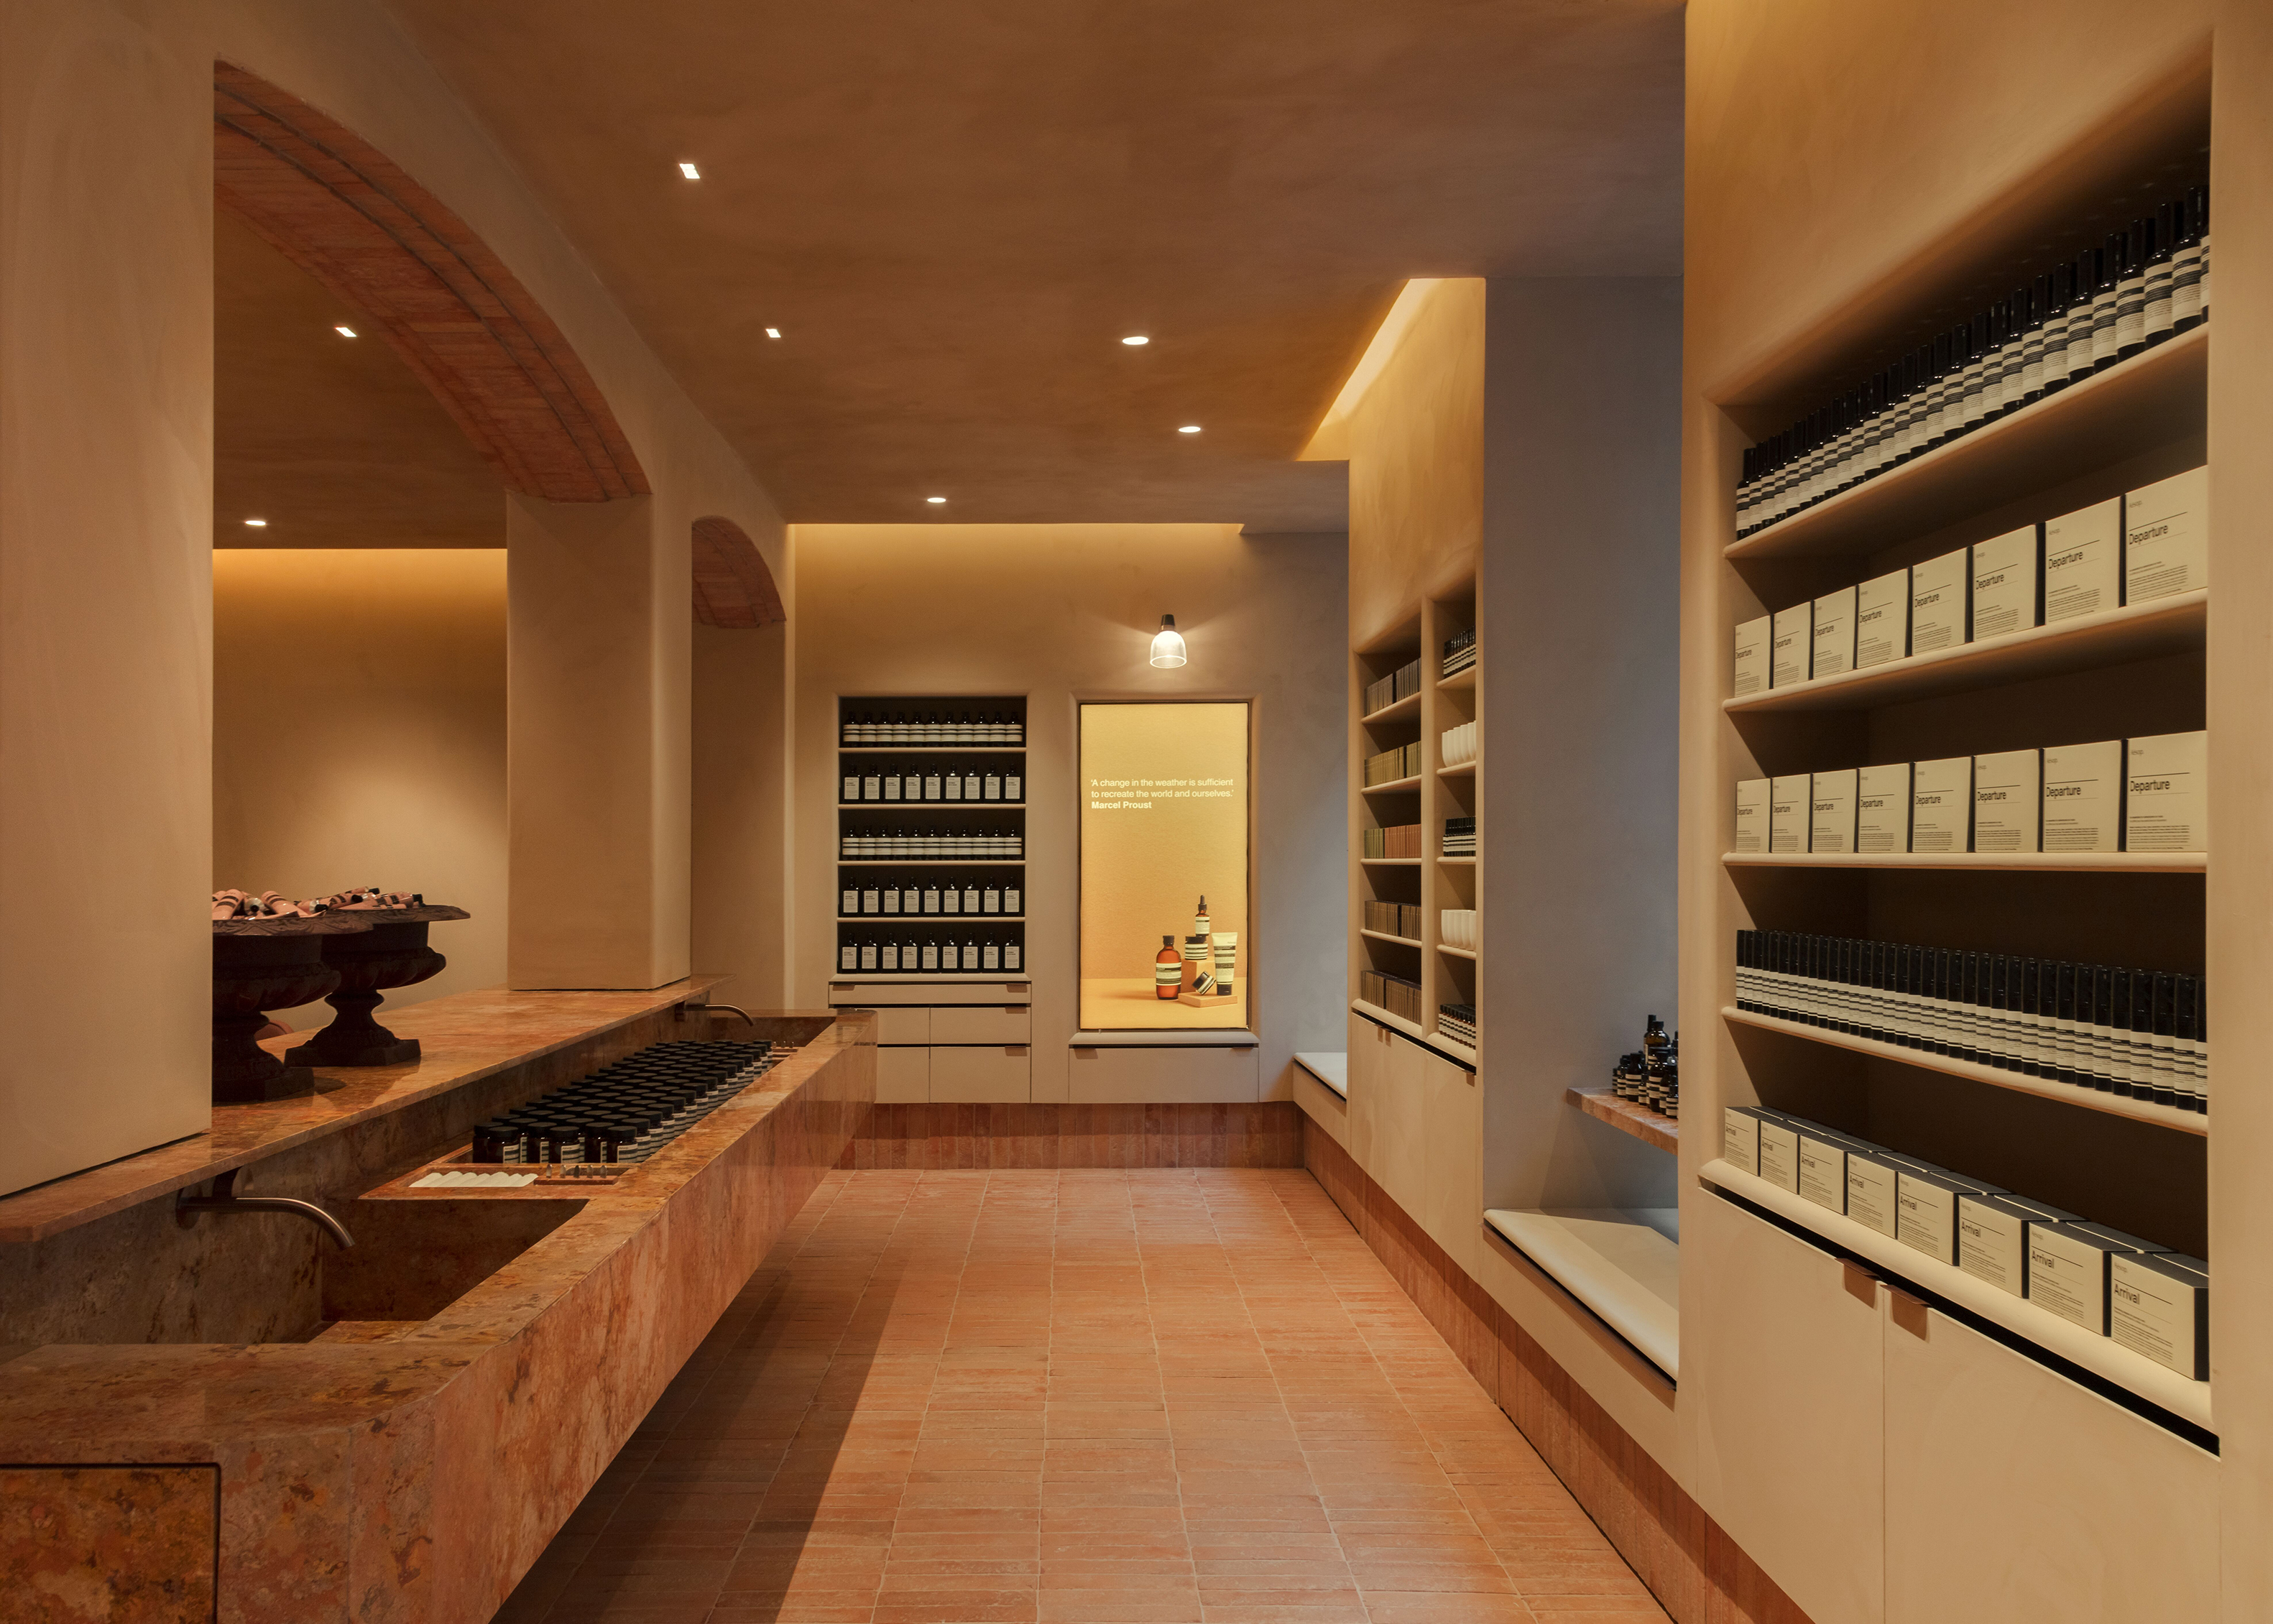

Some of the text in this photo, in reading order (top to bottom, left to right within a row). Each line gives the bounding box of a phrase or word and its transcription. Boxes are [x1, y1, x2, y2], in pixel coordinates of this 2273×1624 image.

[2129, 525, 2169, 545] Departure
[2049, 551, 2083, 569] Departure
[1976, 574, 2004, 590] Departure
[1914, 594, 1940, 608] Departure
[1860, 610, 1882, 624] Departure
[1815, 625, 1834, 637] Departure
[1100, 779, 1130, 788] change
[2130, 780, 2170, 794] Departure
[1978, 791, 2006, 803] Departure
[2046, 786, 2081, 799] Departure
[1861, 799, 1884, 810] Departure
[1916, 795, 1941, 806] Departure
[1814, 803, 1834, 813] Departure
[1802, 1155, 1815, 1168] Arrival
[1849, 1175, 1864, 1189] Arrival
[1900, 1196, 1917, 1211] Arrival
[1961, 1221, 1981, 1238] Arrival
[2032, 1250, 2055, 1269] Arrival
[2113, 1283, 2140, 1305] Arrival
